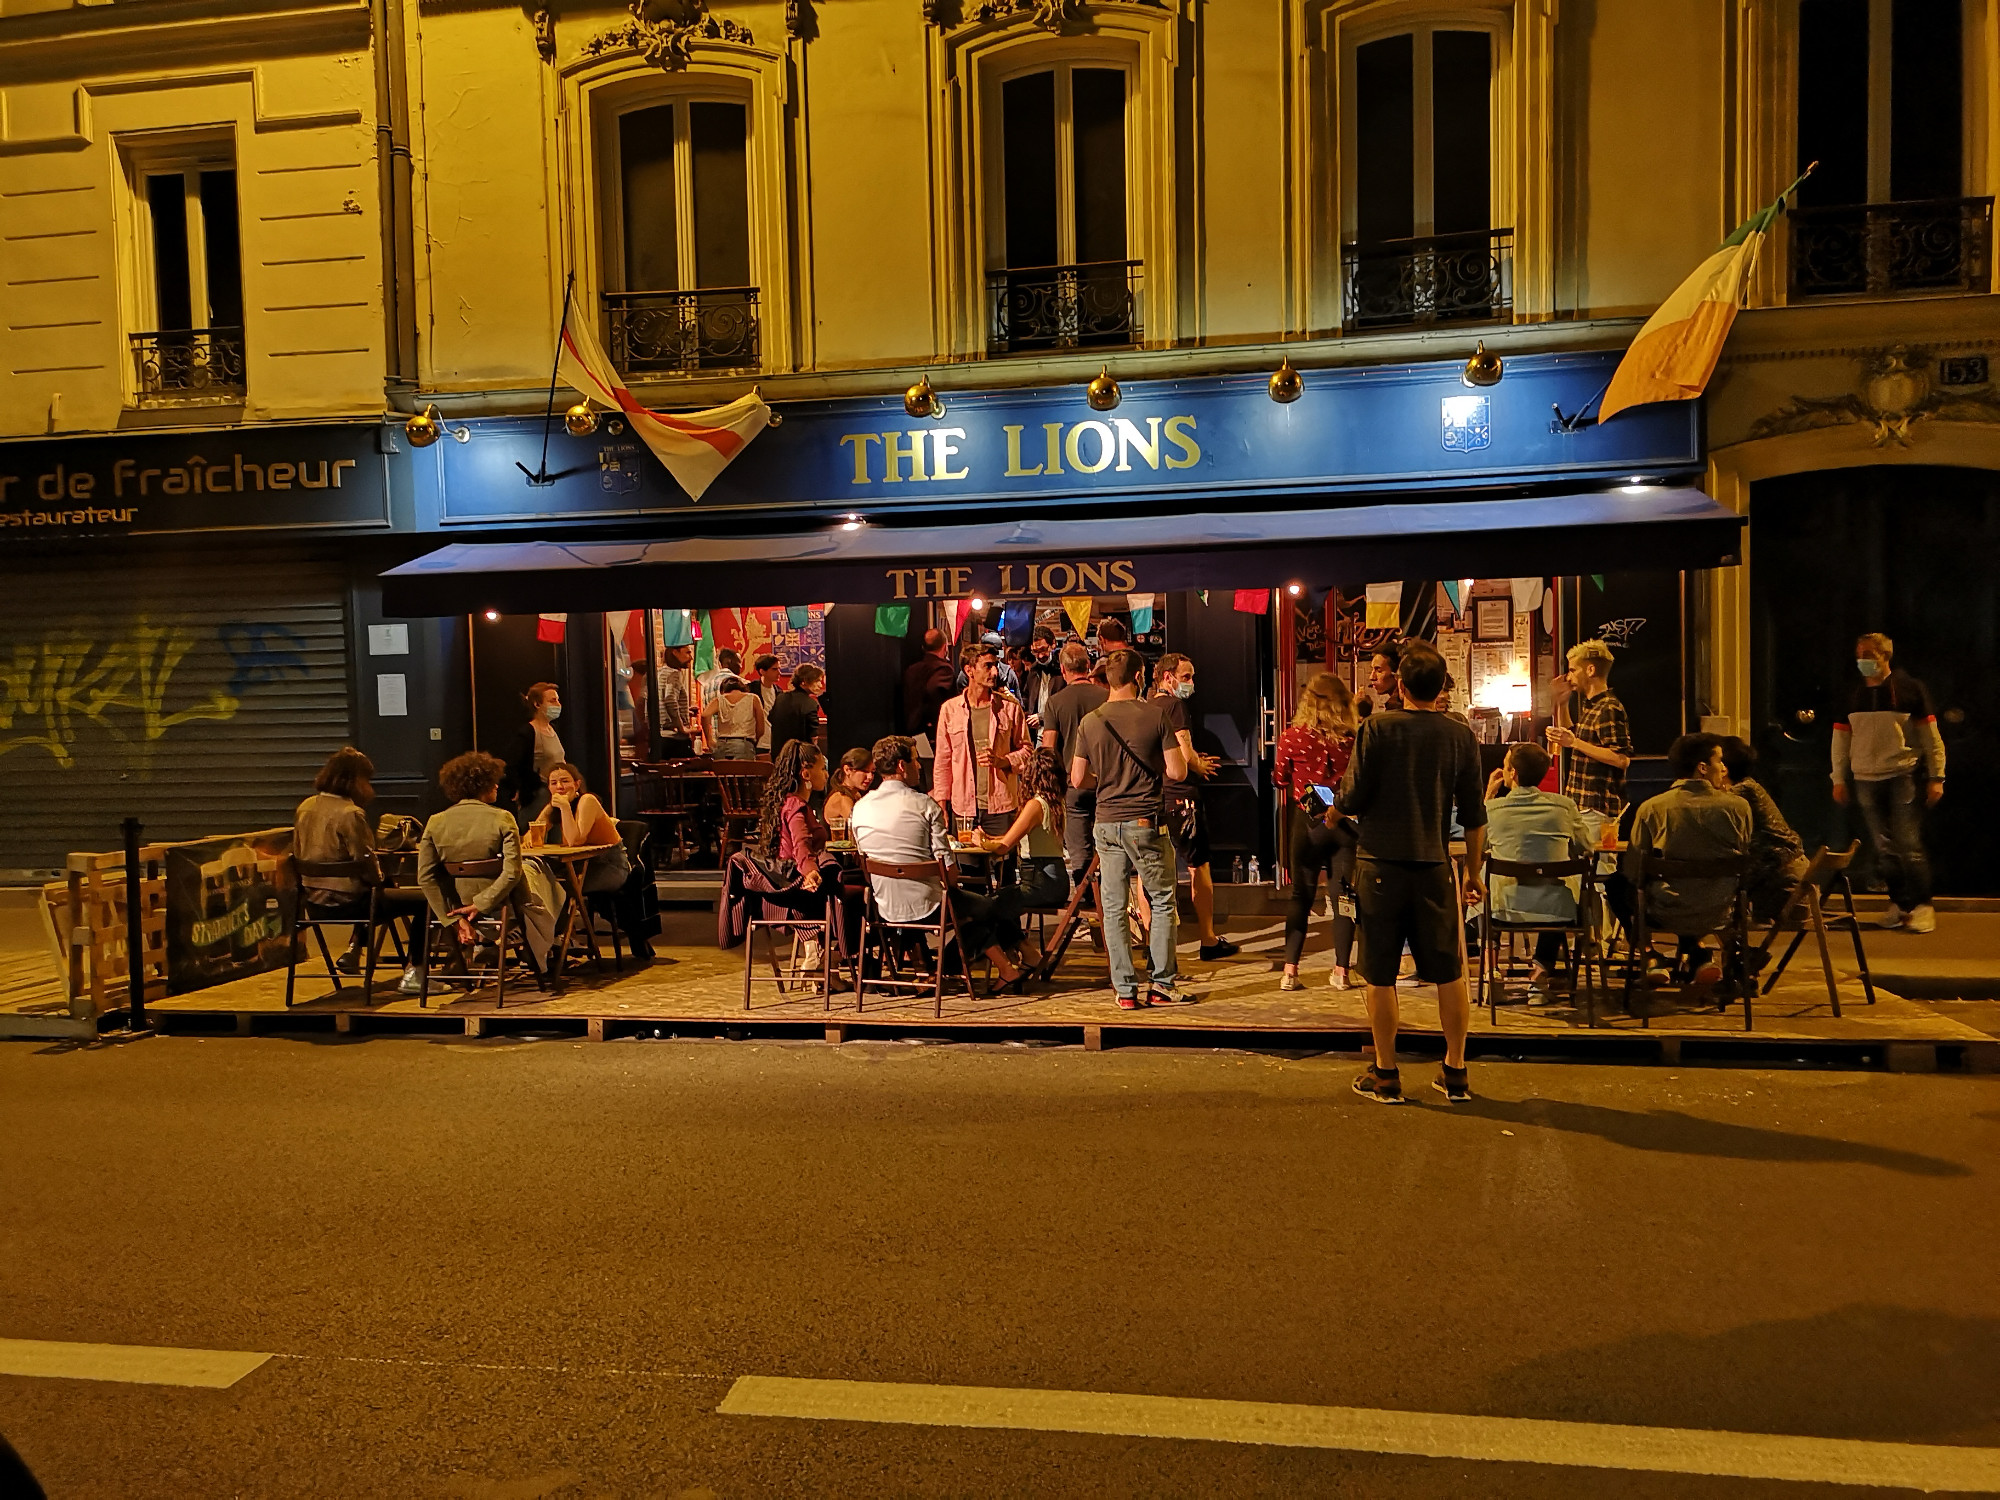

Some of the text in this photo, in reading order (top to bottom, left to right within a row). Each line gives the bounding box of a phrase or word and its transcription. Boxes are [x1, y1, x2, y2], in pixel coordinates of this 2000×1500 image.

[1943, 358, 1983, 383] 153
[840, 415, 1201, 484] THE LIONS
[37, 464, 96, 500] de
[113, 454, 356, 497] fraîcheur
[886, 560, 1137, 599] THE LIONS
[244, 917, 265, 946] DAY
